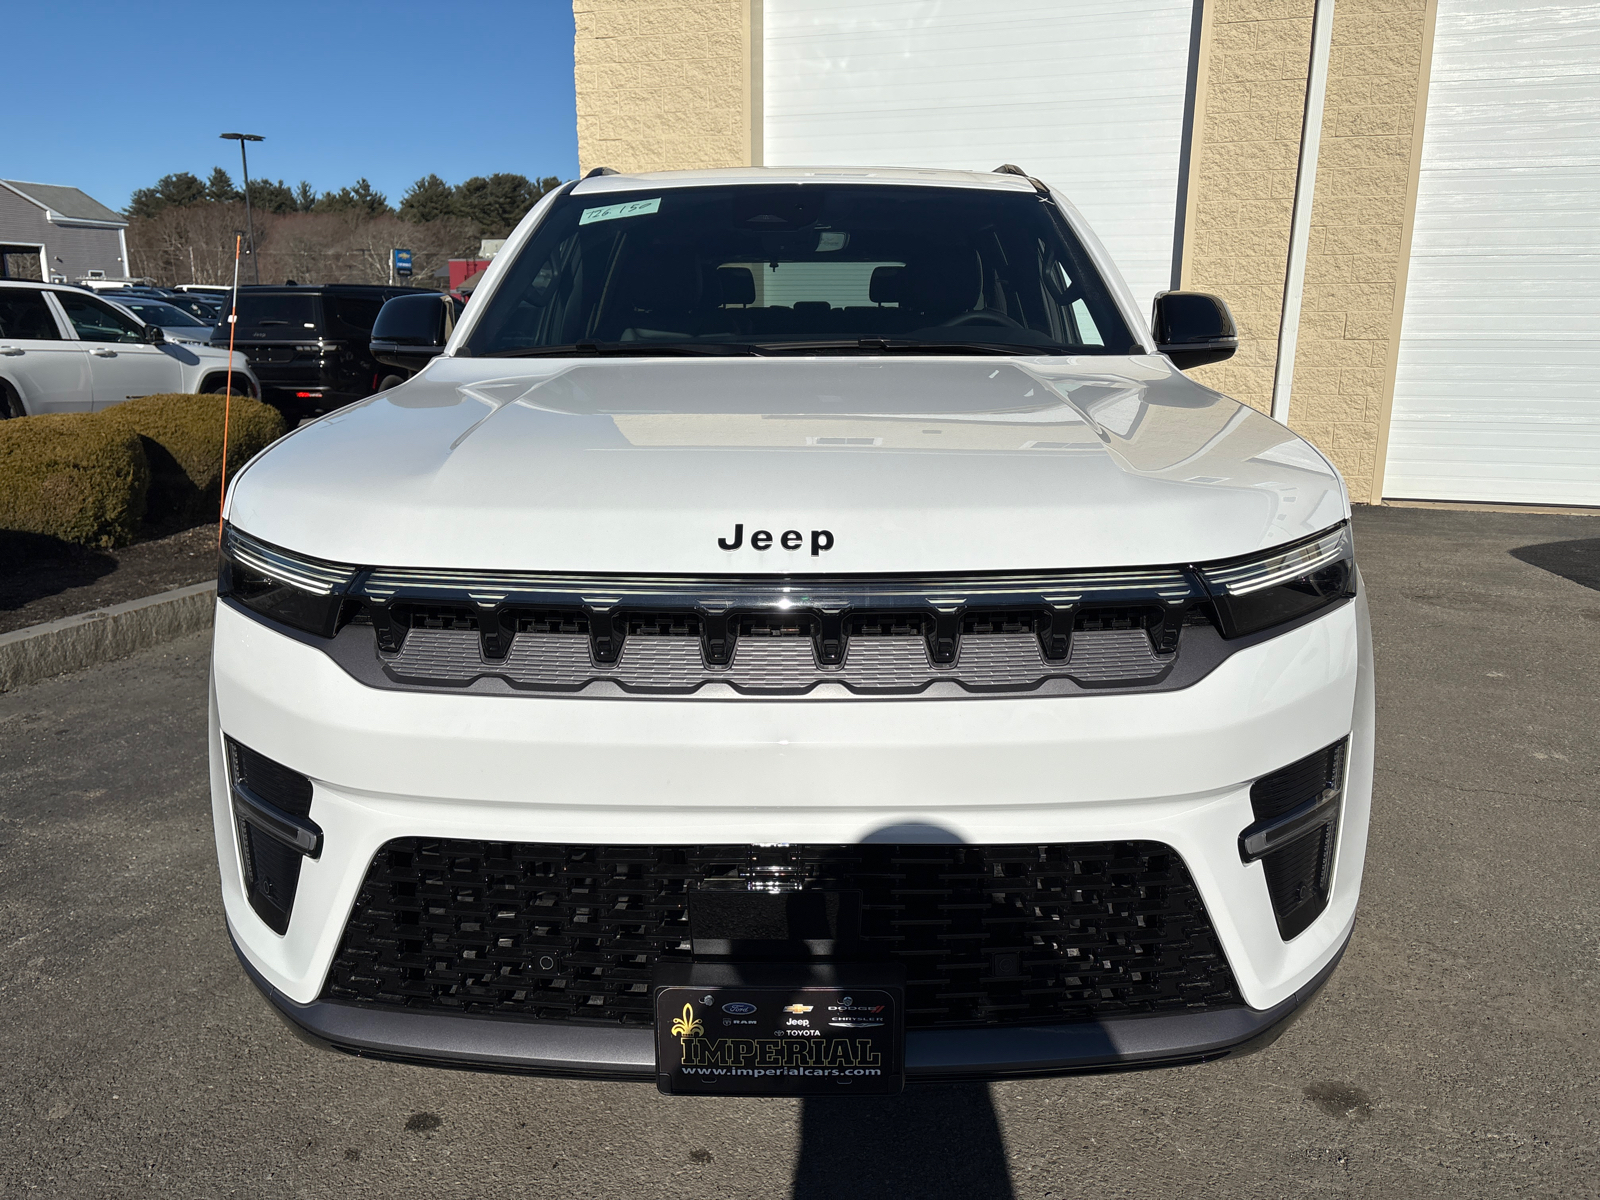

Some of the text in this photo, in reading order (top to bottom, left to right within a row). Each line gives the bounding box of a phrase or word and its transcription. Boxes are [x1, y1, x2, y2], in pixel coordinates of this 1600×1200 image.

[717, 523, 834, 557] Jeep
[729, 1005, 749, 1013] Ford
[785, 1017, 810, 1027] Jeep
[786, 1029, 821, 1037] TOYOTA
[681, 1037, 881, 1066] IMPERIAL
[681, 1067, 881, 1077] www.imperialcars.com
